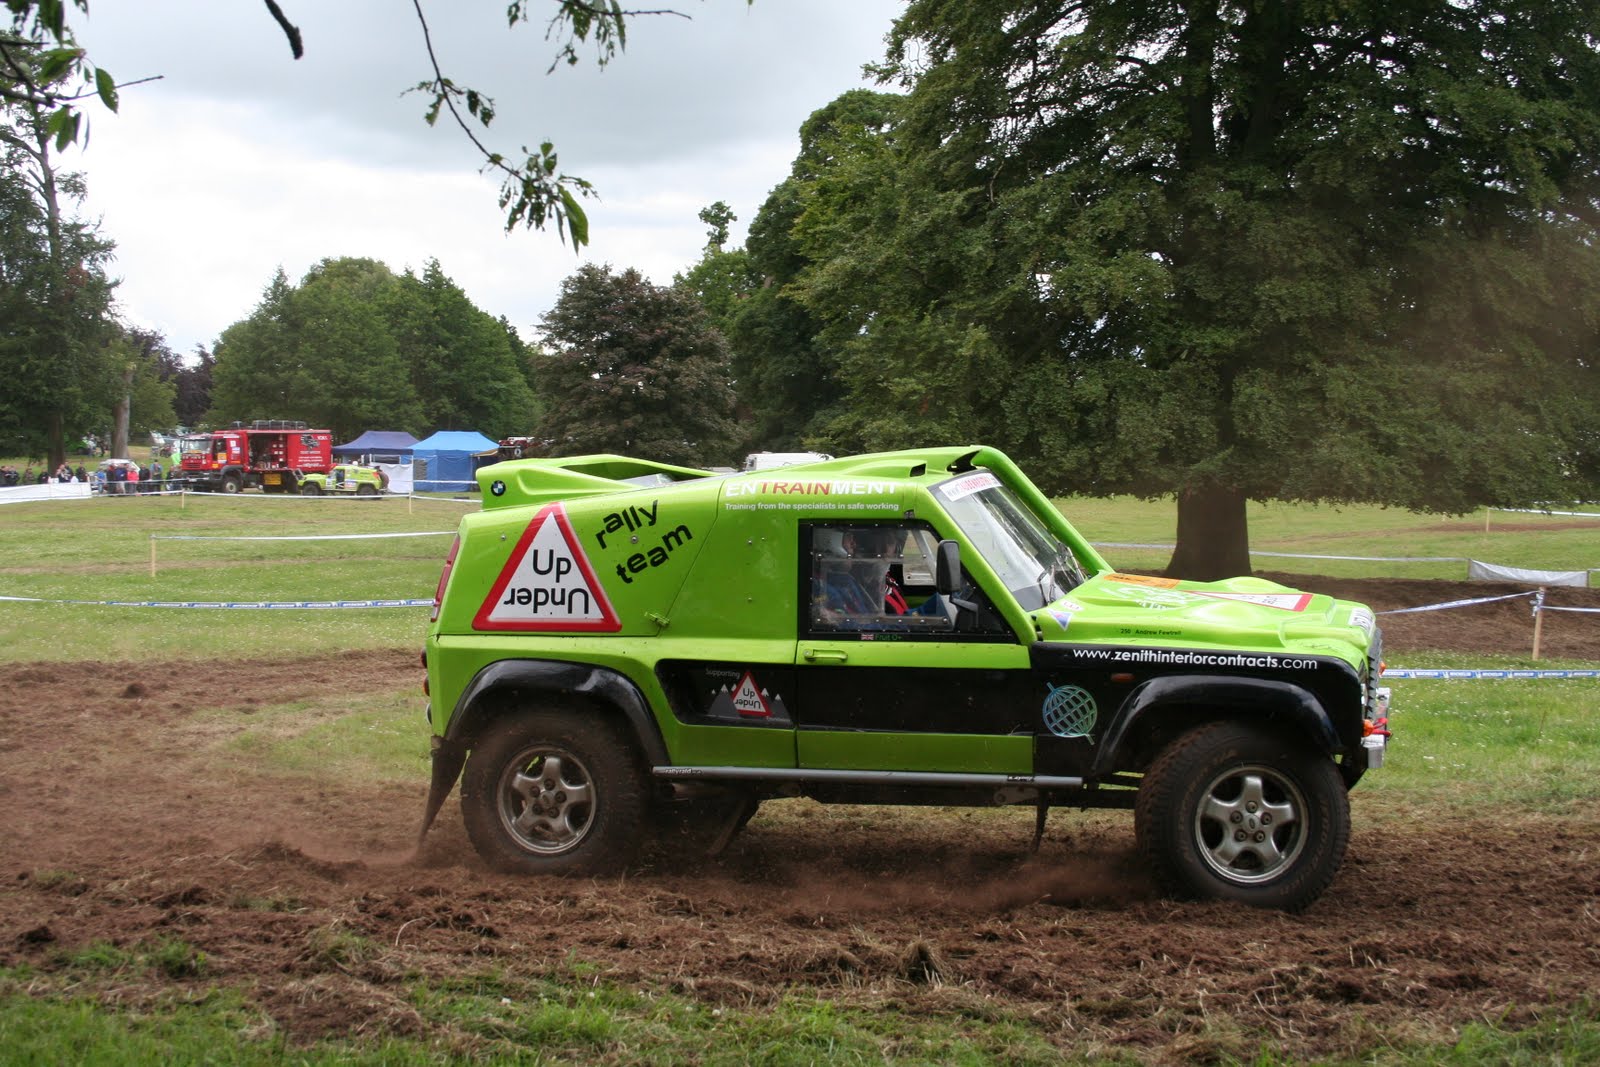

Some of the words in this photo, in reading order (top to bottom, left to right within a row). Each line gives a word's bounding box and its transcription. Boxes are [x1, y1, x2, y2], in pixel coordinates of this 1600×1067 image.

[725, 481, 897, 496] ENTRAINMENT
[725, 502, 756, 511] Training
[757, 502, 777, 510] from
[778, 502, 791, 510] the
[793, 502, 836, 511] specialists
[837, 502, 846, 510] in
[847, 502, 865, 510] safe
[866, 502, 899, 511] working
[595, 500, 659, 549] rally
[616, 525, 693, 584] team
[533, 549, 572, 583] Up
[503, 588, 589, 615] Under
[1072, 648, 1317, 670] www.zenithinteriorcontracts.com
[735, 699, 761, 709] Under
[742, 687, 755, 699] Up
